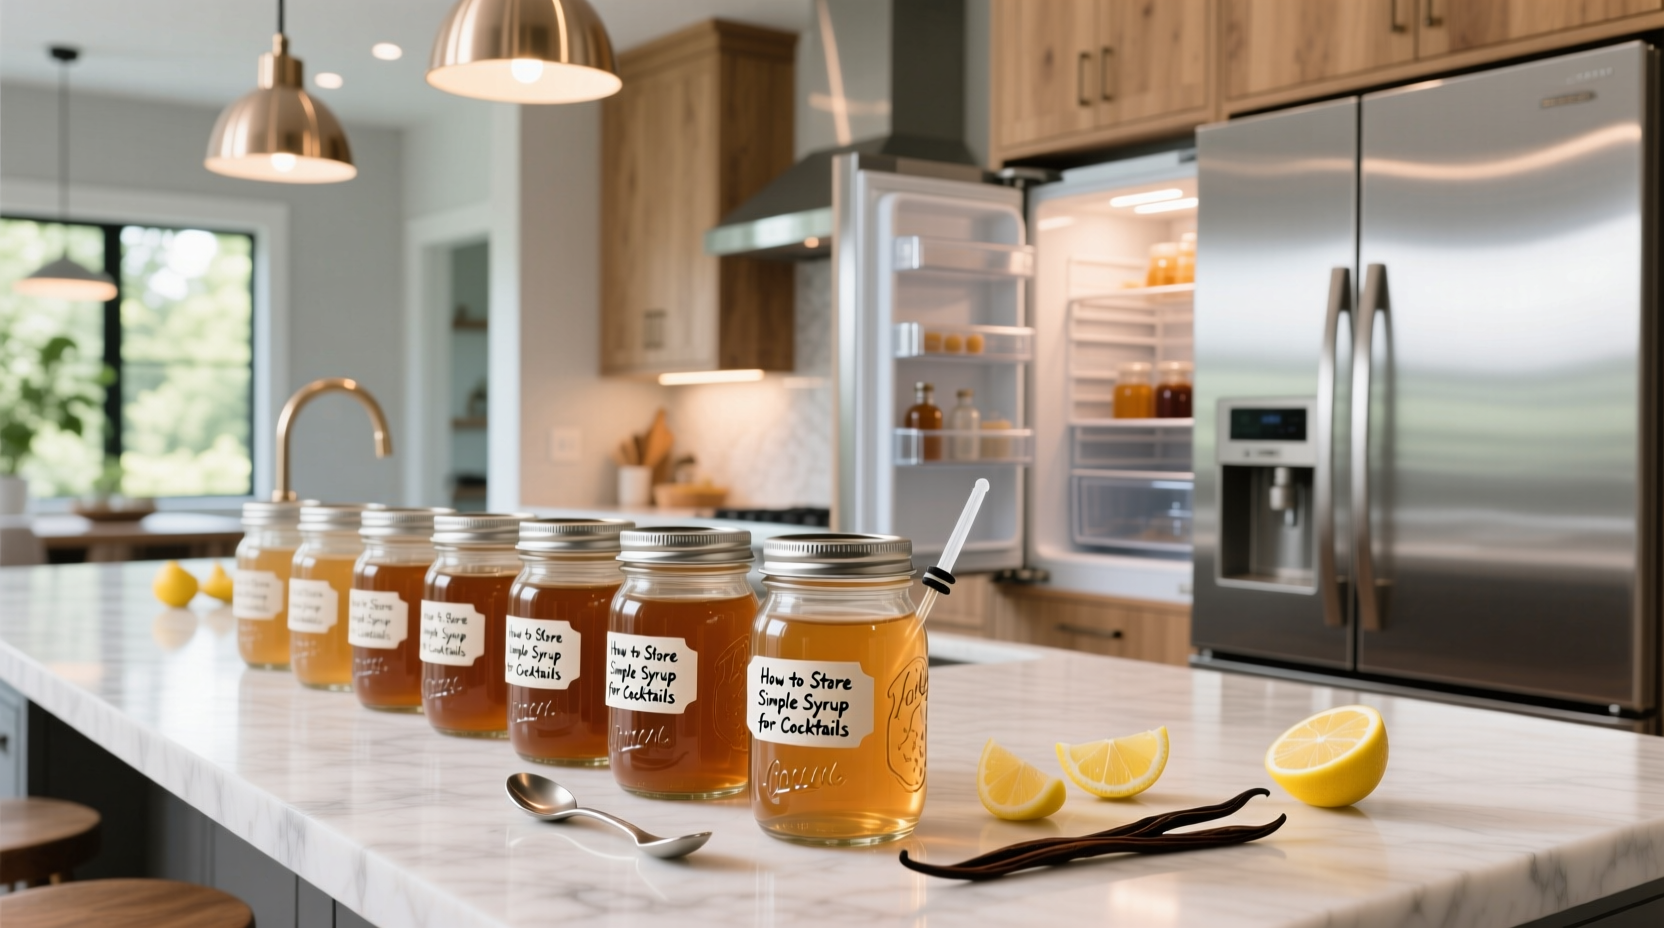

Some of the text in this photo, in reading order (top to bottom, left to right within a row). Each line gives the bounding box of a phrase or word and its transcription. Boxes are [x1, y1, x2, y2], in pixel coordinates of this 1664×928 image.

[532, 645, 561, 666] Syrup
[610, 640, 678, 663] How to Store
[610, 660, 677, 687] Simple Syrup
[760, 666, 853, 691] How to Store
[623, 685, 676, 704] Cocktails
[758, 689, 850, 718] Simple Syrup
[758, 712, 850, 737] for Cocktails
